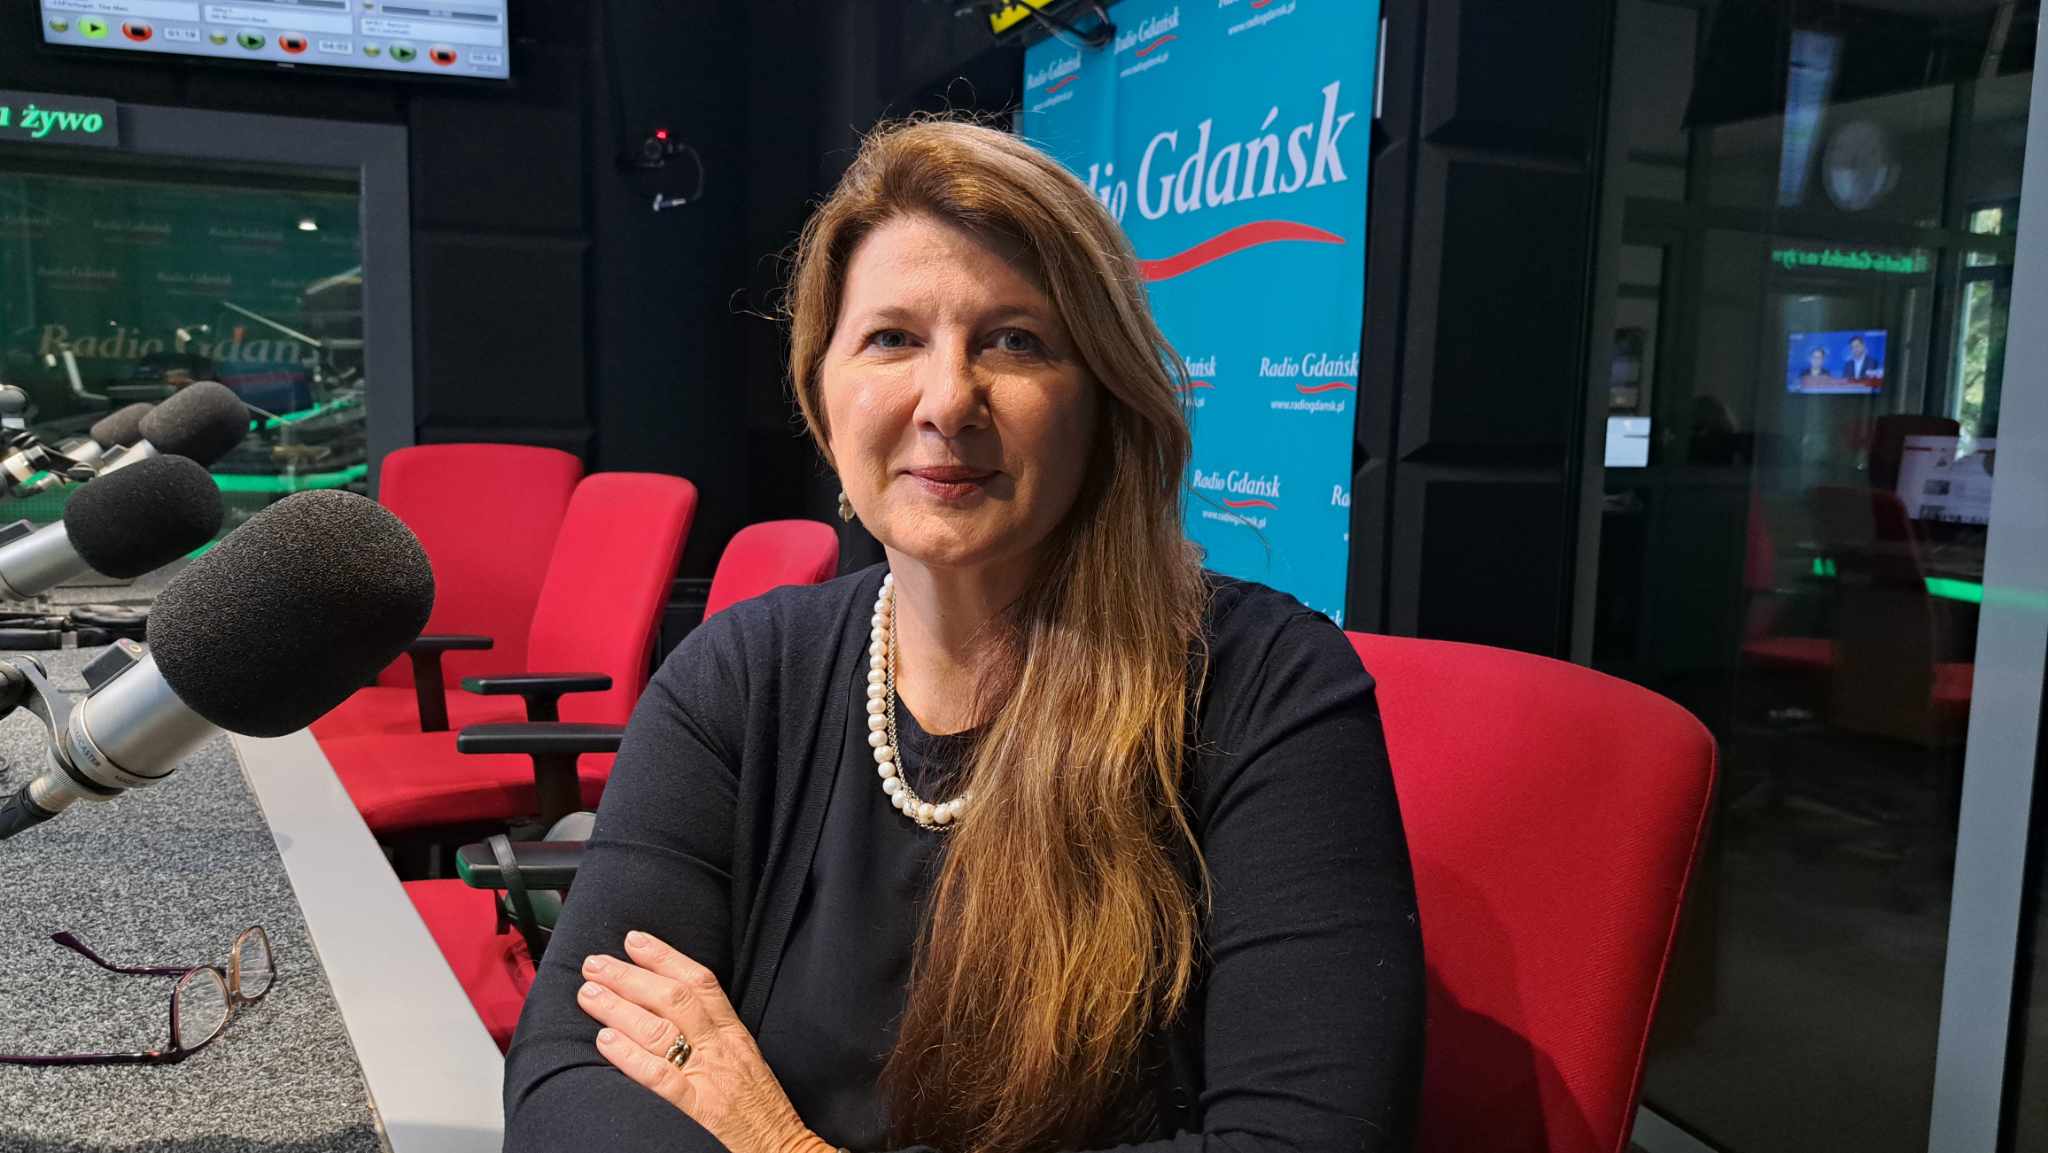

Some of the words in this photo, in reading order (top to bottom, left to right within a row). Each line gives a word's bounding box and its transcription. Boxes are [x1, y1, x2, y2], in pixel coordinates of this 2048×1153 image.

[1113, 30, 1138, 55] Radio
[1138, 6, 1180, 43] Gdańsk
[19, 103, 103, 138] żywo
[1137, 80, 1355, 221] Gdańsk
[38, 323, 165, 360] Radio
[1183, 354, 1217, 378] dańsk
[1258, 355, 1300, 378] Radio
[1300, 351, 1360, 378] Gdańsk
[1193, 469, 1225, 492] Radio
[1226, 470, 1281, 498] Gdańsk
